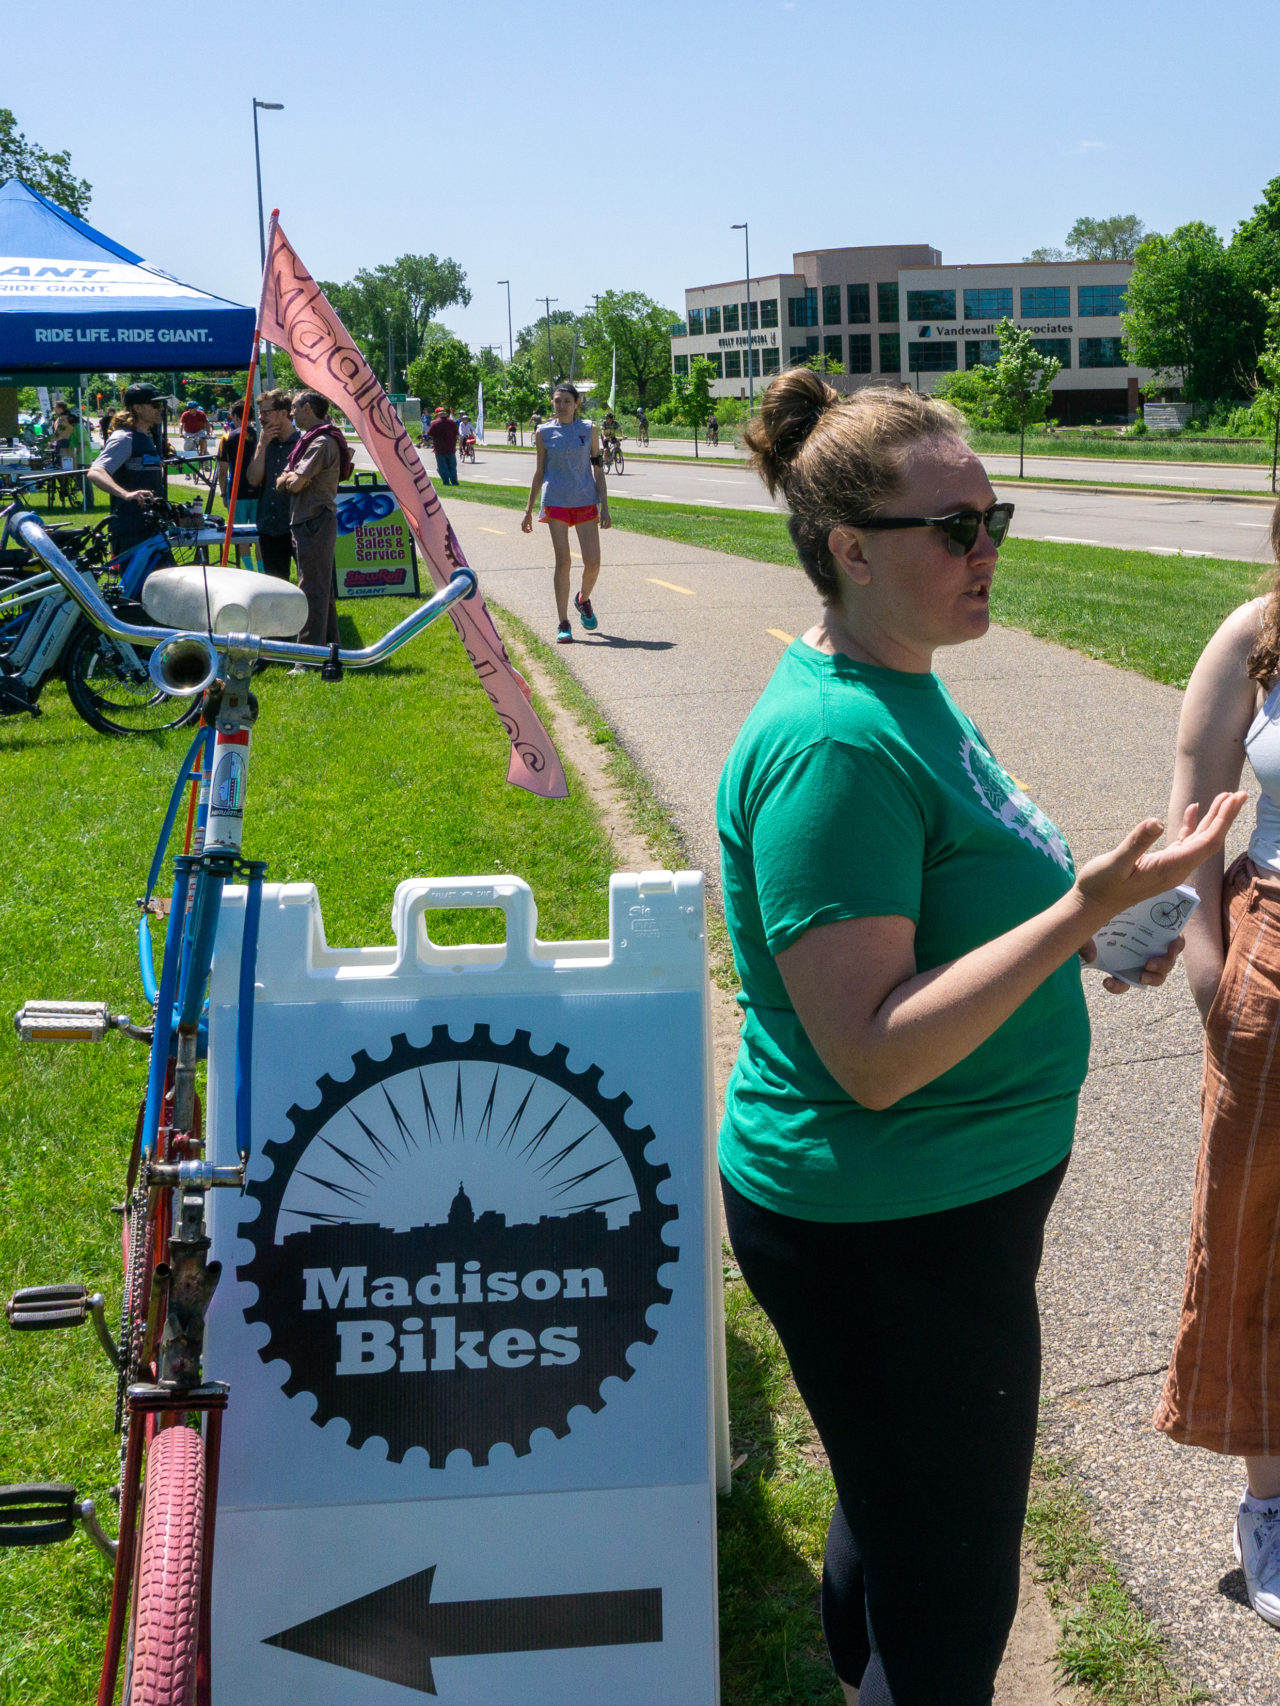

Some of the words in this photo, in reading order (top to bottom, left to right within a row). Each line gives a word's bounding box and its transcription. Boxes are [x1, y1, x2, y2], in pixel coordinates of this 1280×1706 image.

[35, 328, 73, 342] RIDE
[77, 328, 116, 342] LIFE.
[118, 328, 154, 342] RIDE
[158, 328, 213, 342] GIANT.
[936, 325, 998, 336] Vandewall
[355, 524, 403, 538] Bicycle
[356, 537, 392, 549] Sales
[395, 537, 405, 548] &
[356, 549, 405, 561] Service
[355, 587, 386, 595] GIANT
[302, 1260, 608, 1311] Madison
[335, 1316, 581, 1376] Bikes
